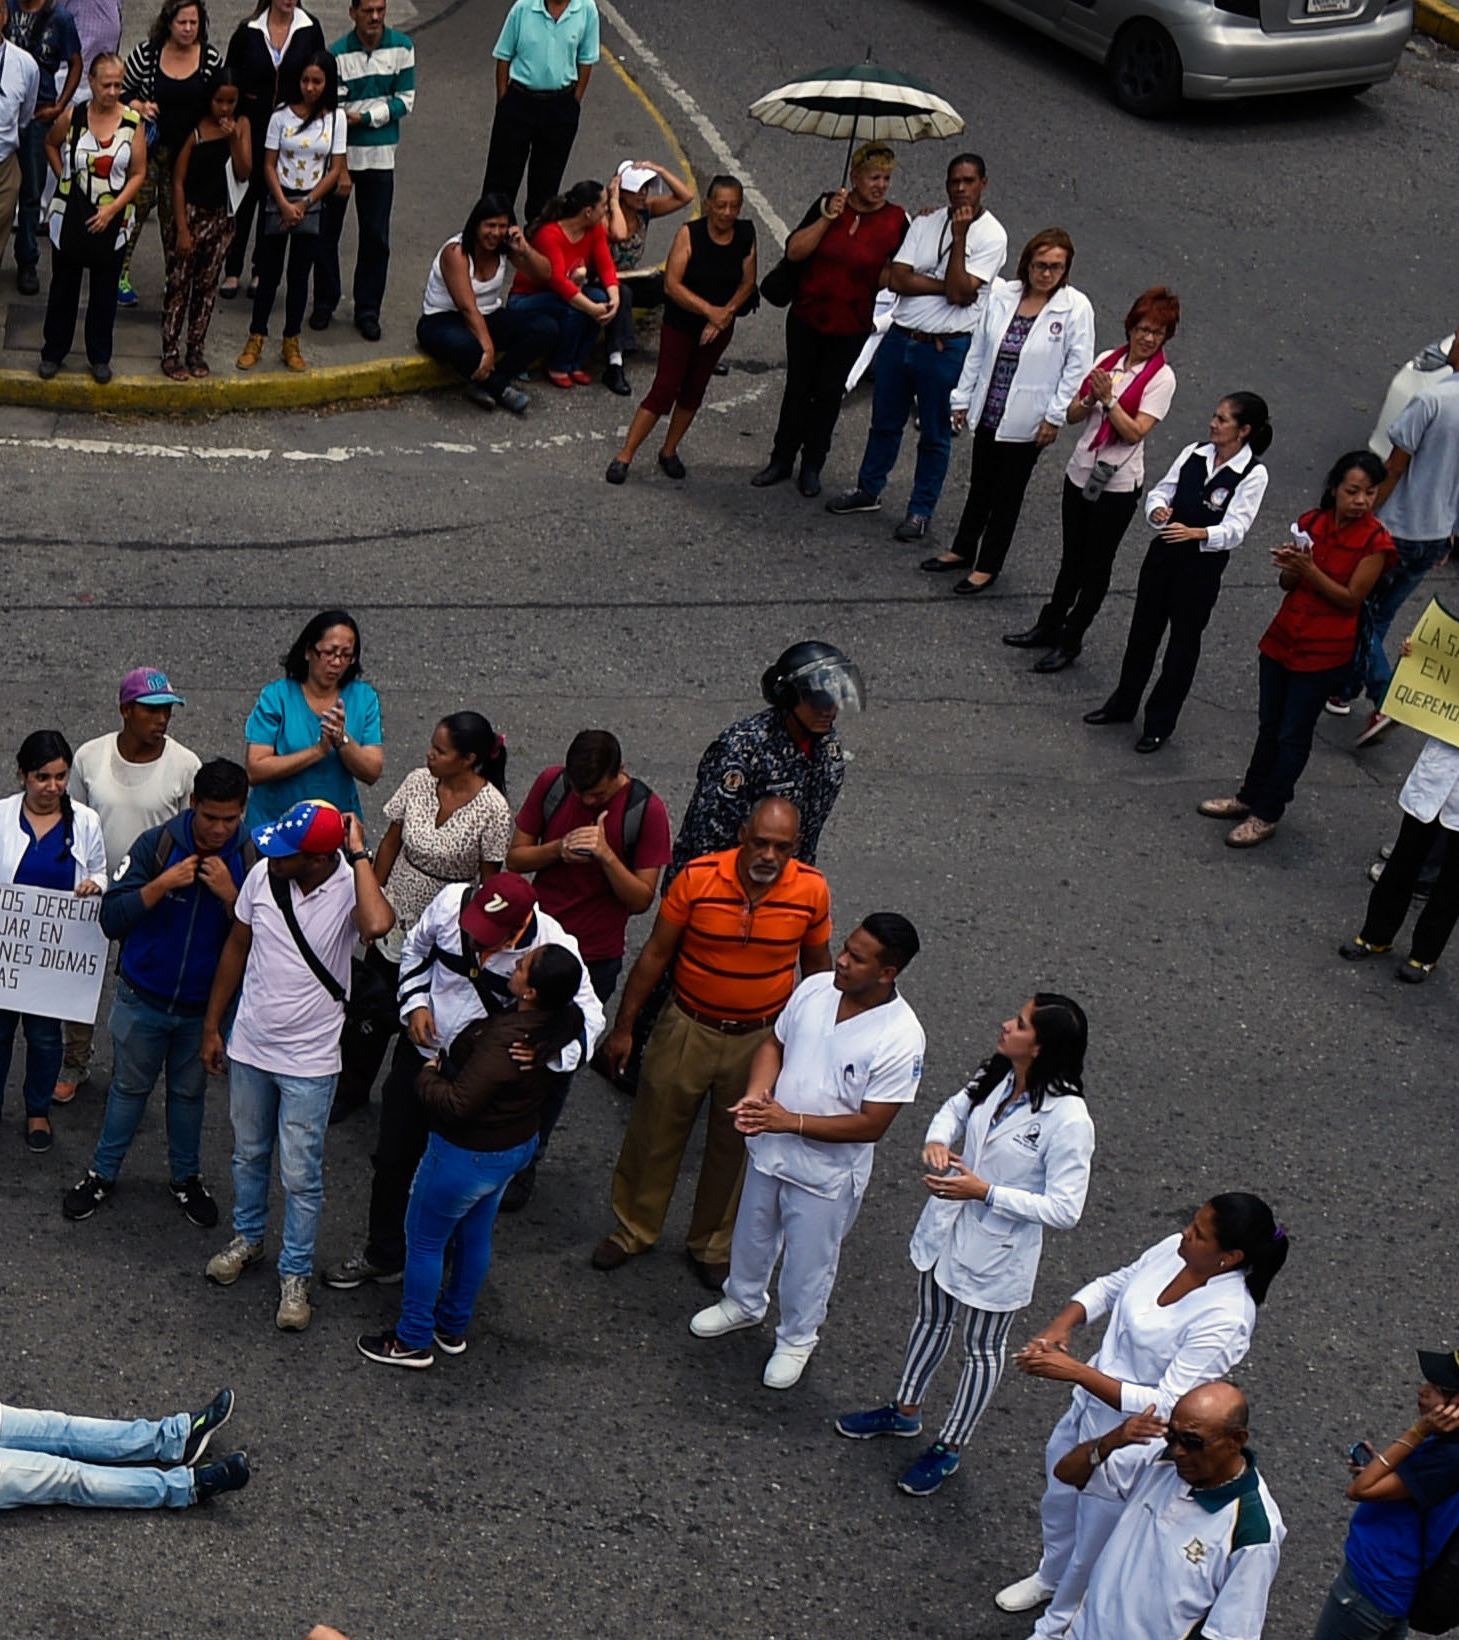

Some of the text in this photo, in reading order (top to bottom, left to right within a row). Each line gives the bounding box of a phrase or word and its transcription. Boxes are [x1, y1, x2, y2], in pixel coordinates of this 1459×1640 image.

[1417, 618, 1440, 649] LA
[1420, 656, 1451, 685] EN
[1395, 684, 1459, 722] QUEREMO
[39, 922, 64, 944] EN
[39, 947, 99, 976] DIGNAS
